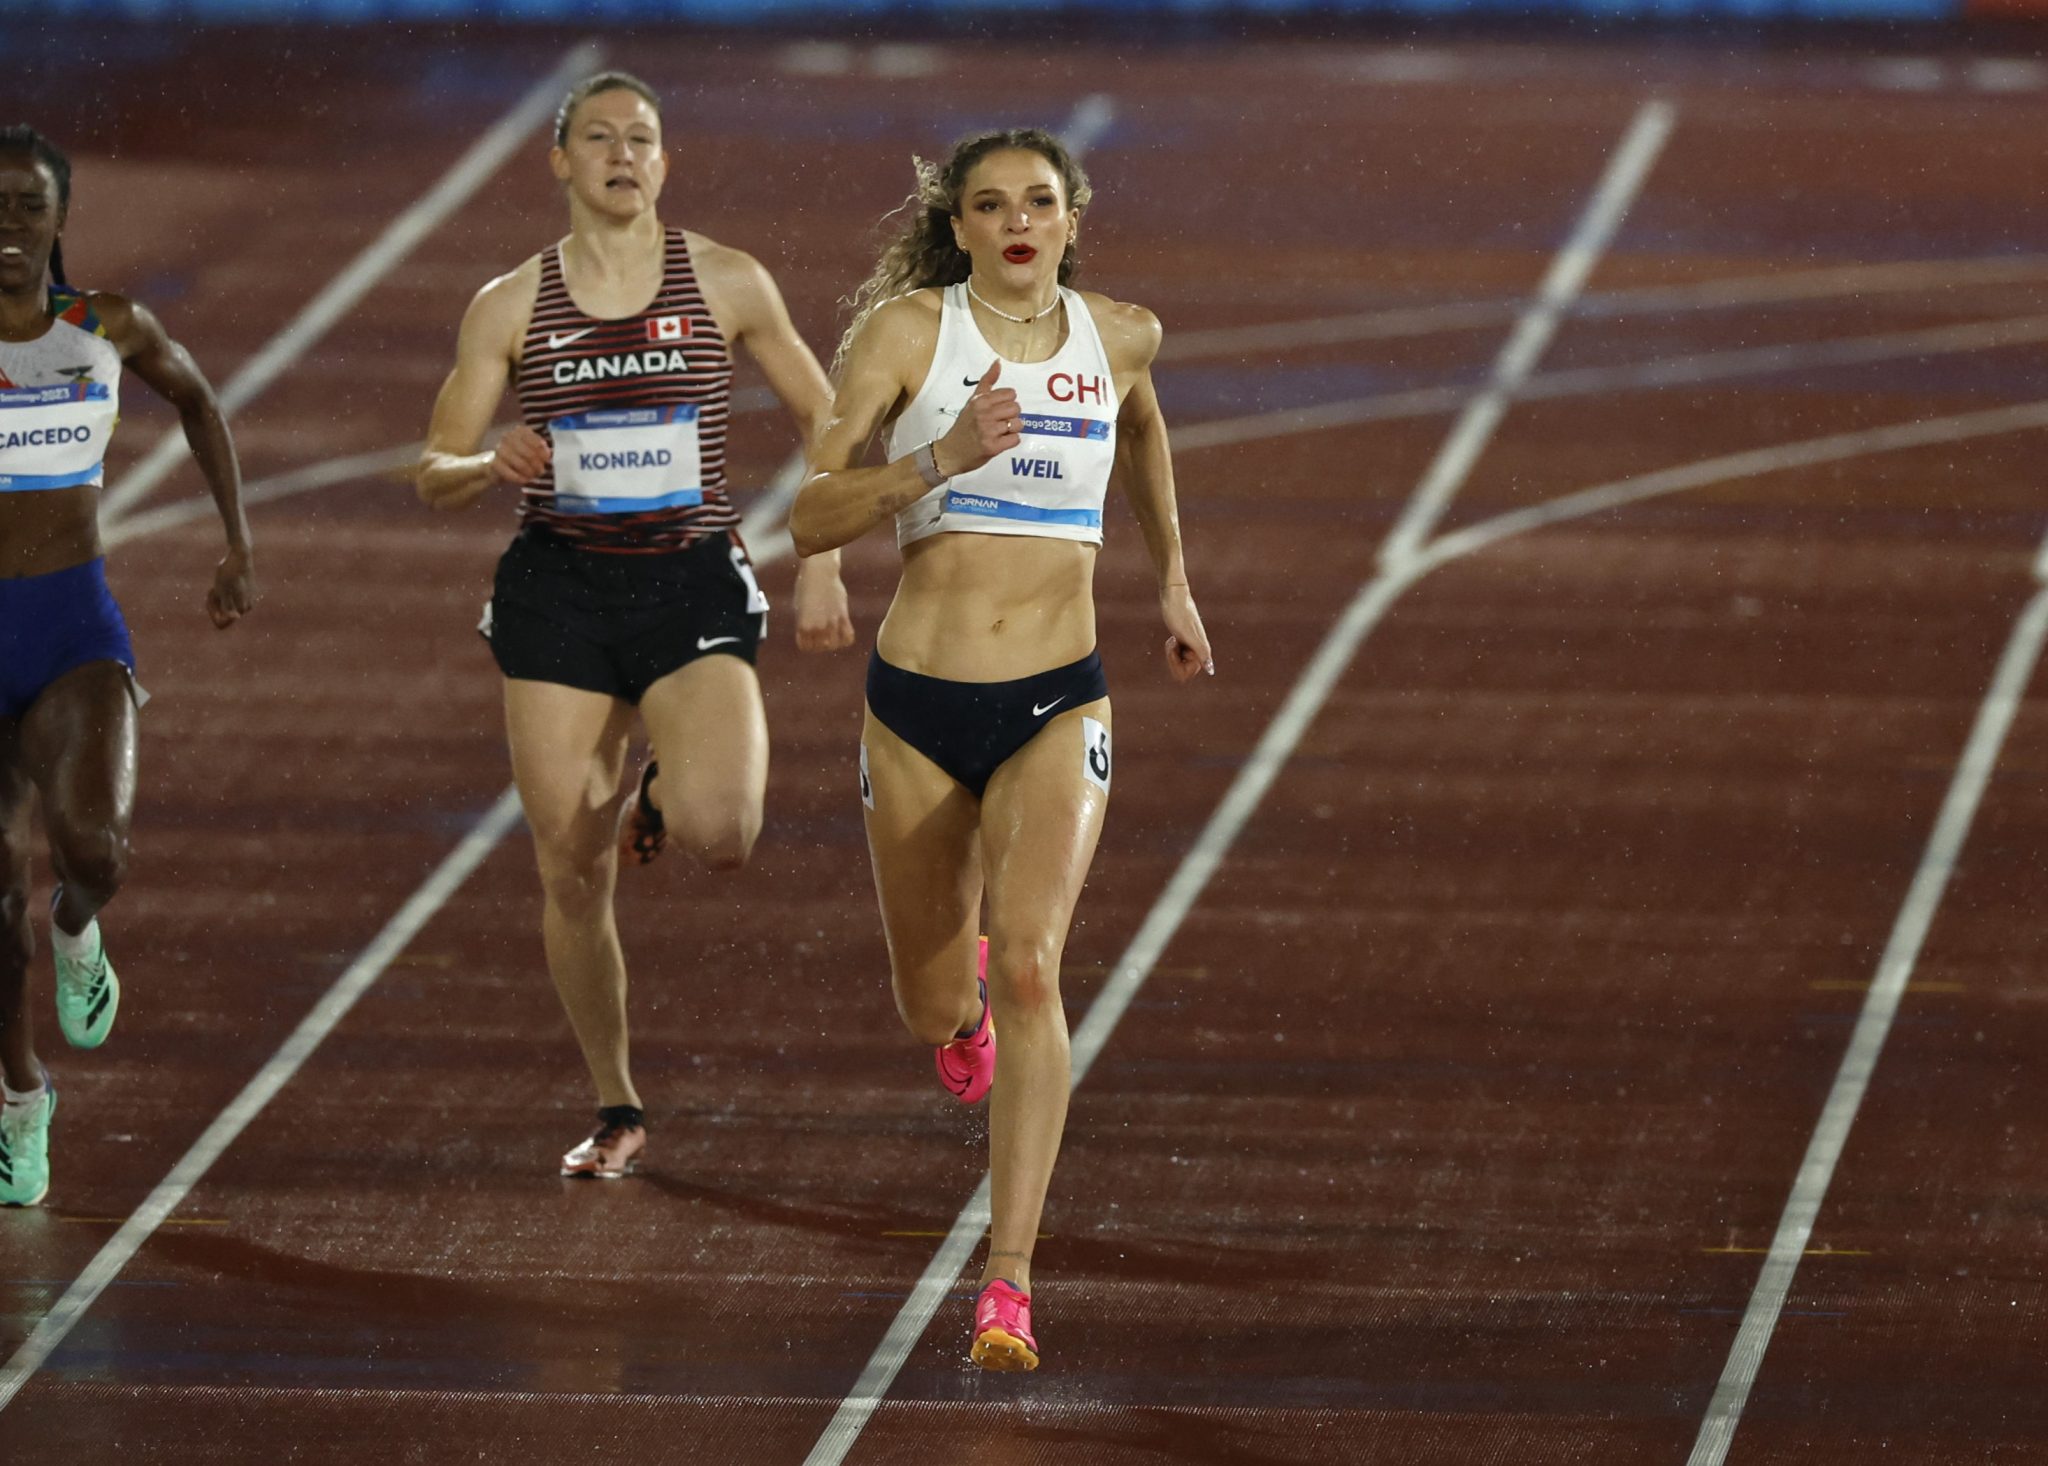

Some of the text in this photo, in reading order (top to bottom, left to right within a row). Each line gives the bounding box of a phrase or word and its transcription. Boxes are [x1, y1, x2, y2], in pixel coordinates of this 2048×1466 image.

[553, 349, 688, 384] CANADA
[1022, 418, 1072, 433] iago2023
[580, 449, 672, 470] KONRAD
[1011, 457, 1063, 480] WEIL
